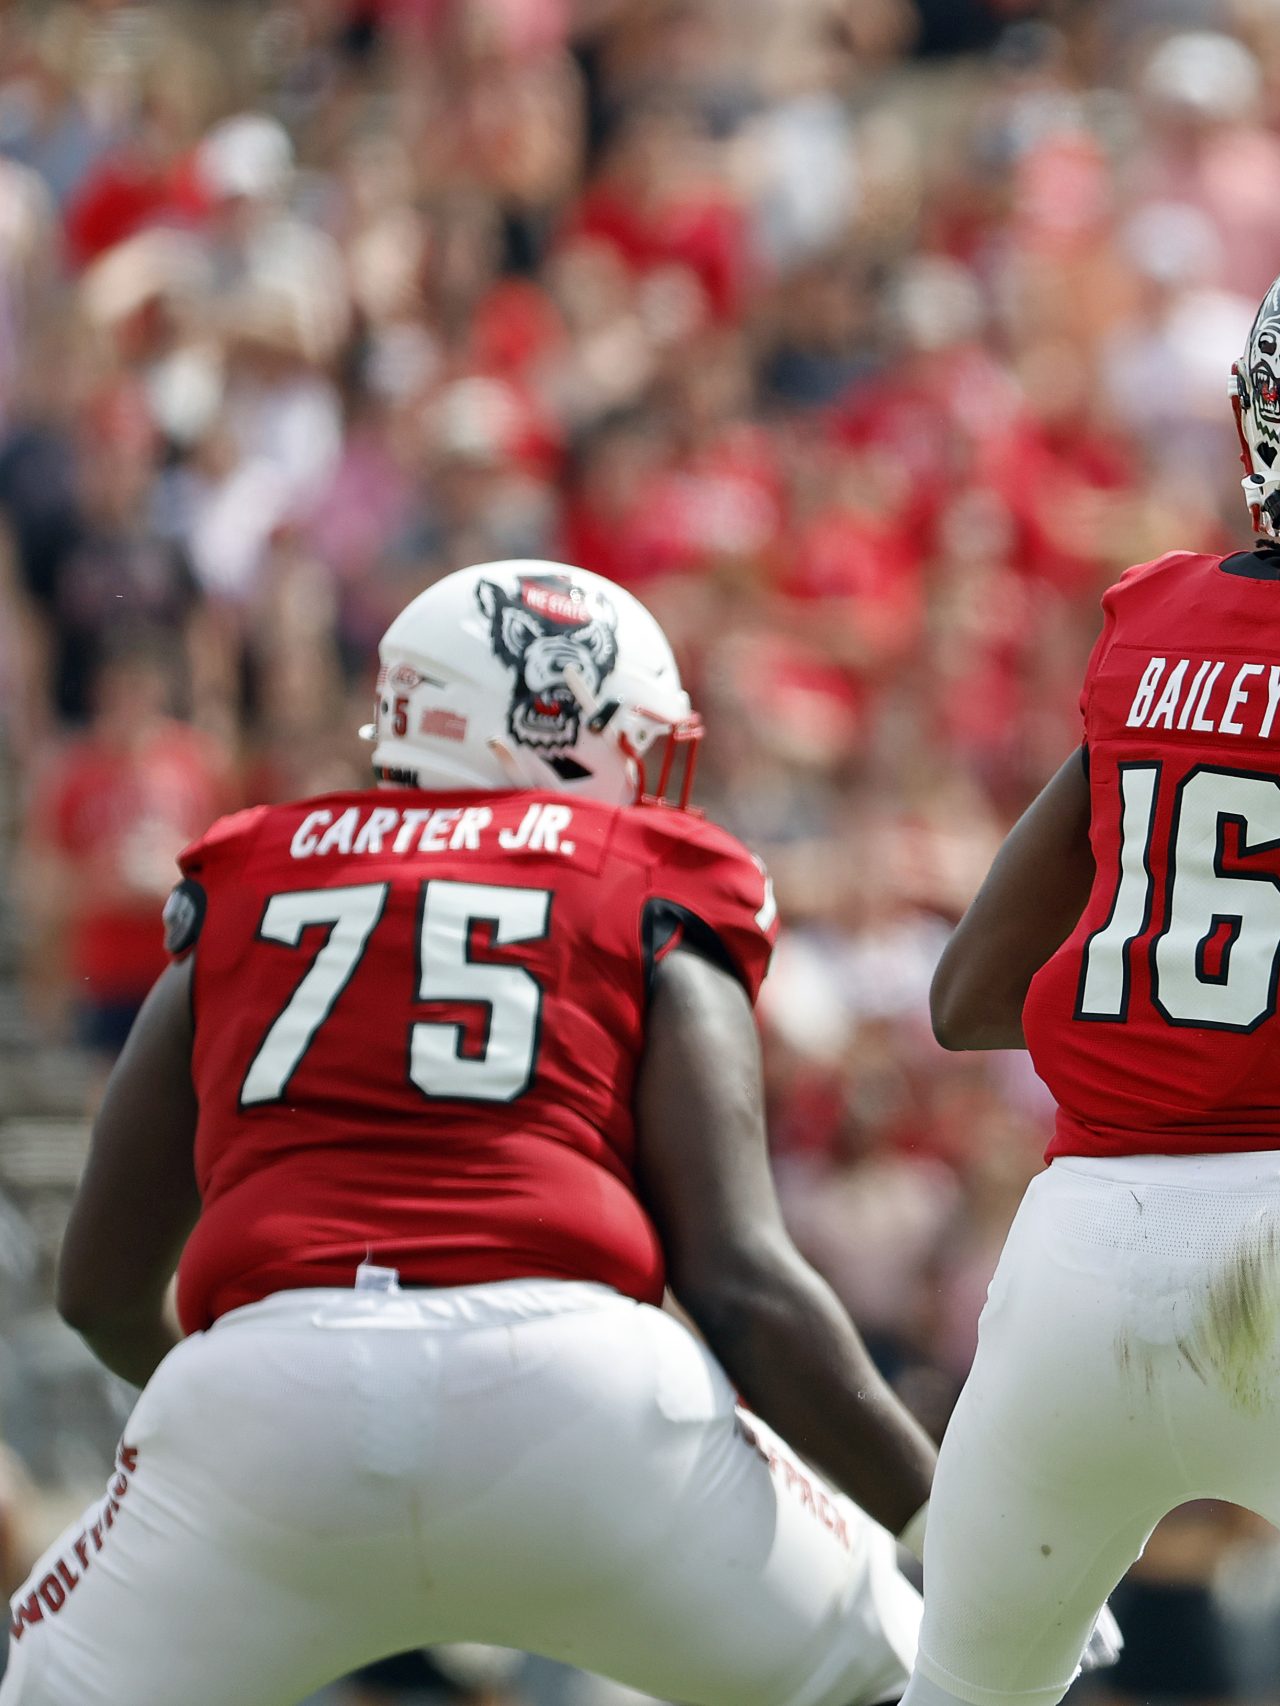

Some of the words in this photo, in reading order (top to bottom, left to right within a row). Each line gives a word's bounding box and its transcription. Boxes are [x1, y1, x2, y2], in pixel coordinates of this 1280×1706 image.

[289, 806, 481, 860] CARTER
[498, 803, 577, 857] JR.
[238, 878, 554, 1112] 75
